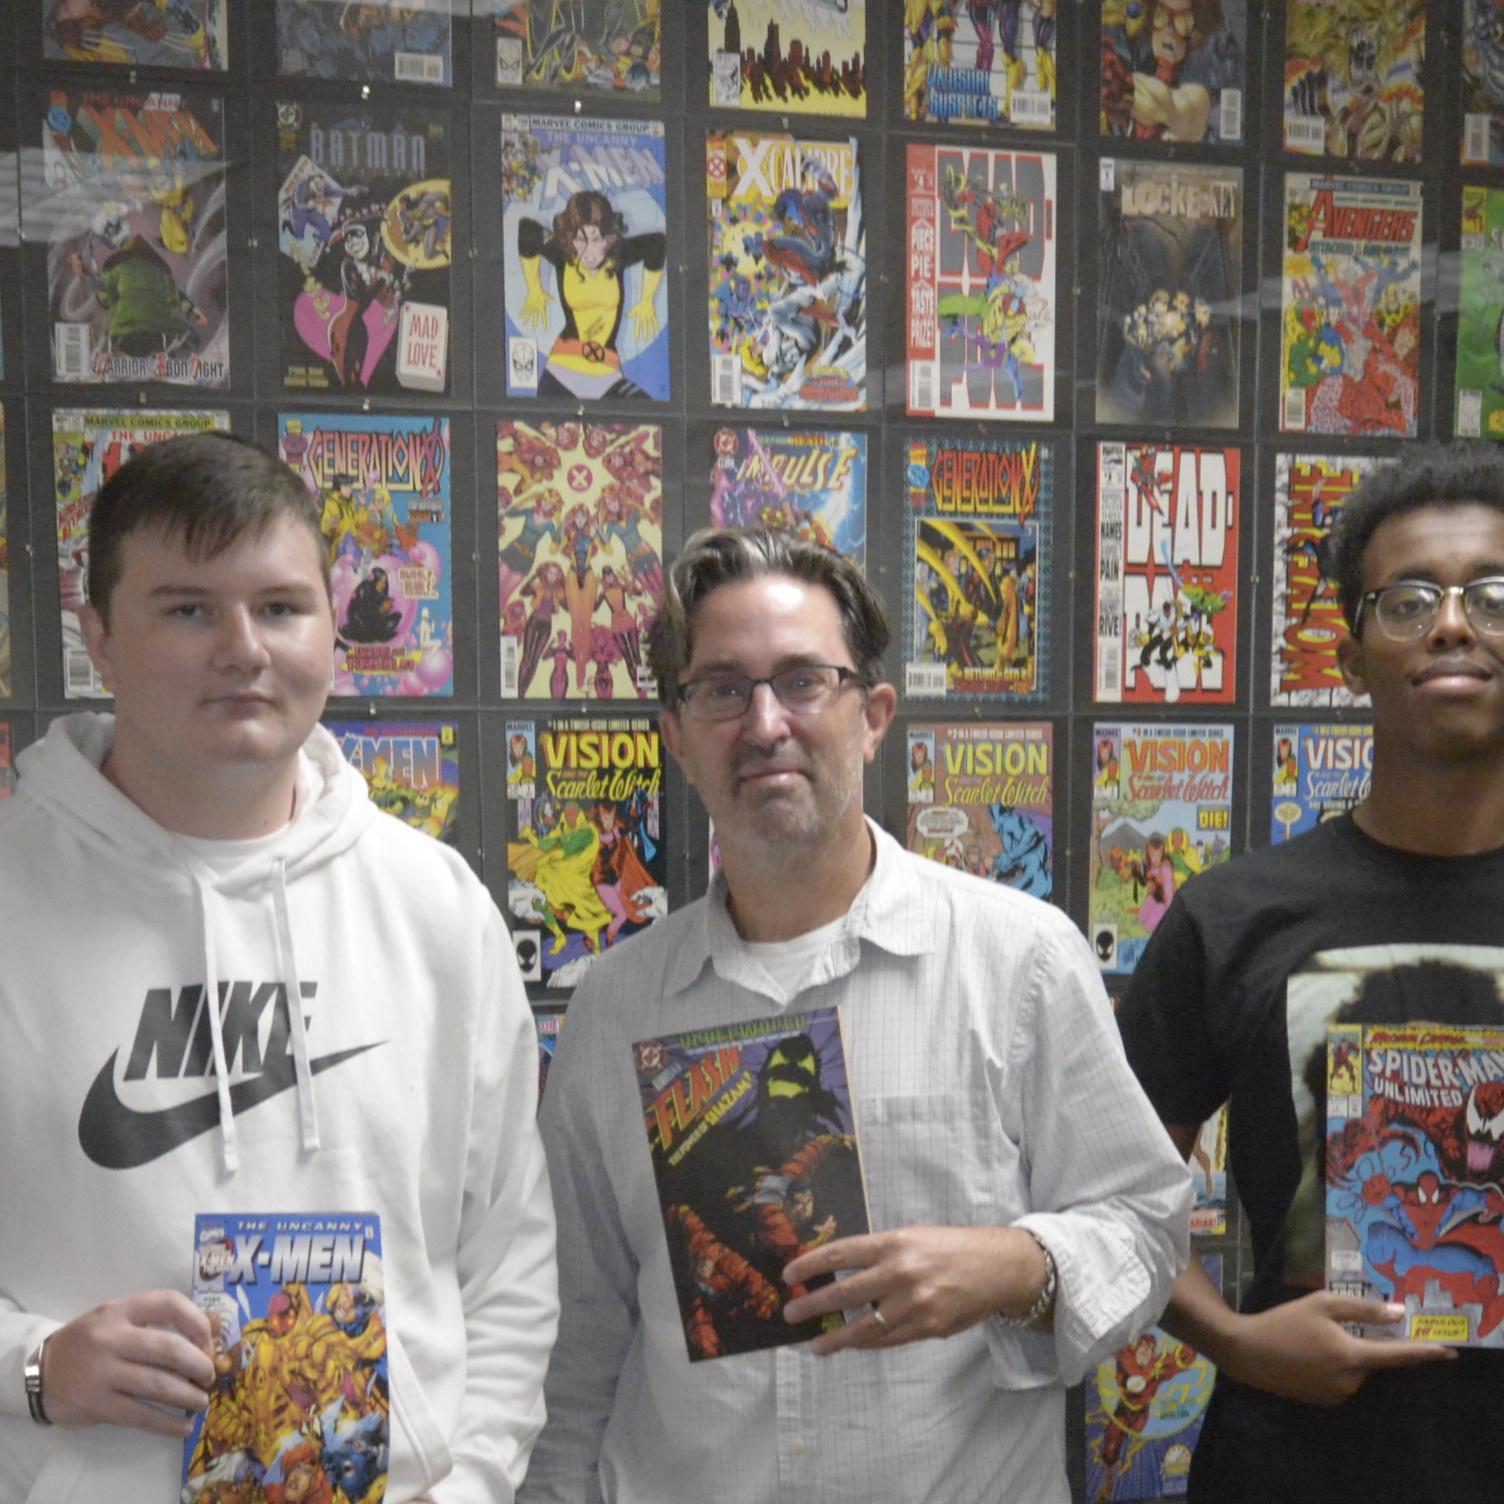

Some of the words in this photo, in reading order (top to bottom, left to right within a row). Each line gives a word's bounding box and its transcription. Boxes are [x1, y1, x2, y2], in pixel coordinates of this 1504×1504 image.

[532, 118, 571, 130] MARVEL
[574, 121, 612, 132] COMICS
[616, 122, 650, 134] GROUP
[548, 131, 574, 144] THE
[577, 132, 637, 147] UNCANNY
[310, 127, 426, 171] BATMAN
[539, 144, 663, 205] X-MEN
[1296, 172, 1418, 253] AVENGERS
[911, 224, 933, 251] PIECE
[409, 310, 439, 338] MAD
[407, 340, 439, 372] LOVE
[84, 417, 129, 427] MARVEL
[130, 417, 173, 427] COMICS
[175, 418, 212, 429] GROUP
[112, 430, 134, 441] THE
[540, 732, 661, 771] VISION
[944, 742, 1049, 776] VISION
[1126, 739, 1230, 773] VISION
[547, 769, 607, 799] Scarlet
[608, 768, 661, 803] Witch
[944, 777, 999, 806] Scarlet
[1000, 777, 1048, 804] Witch
[1127, 773, 1183, 802] Scarlet
[1183, 774, 1230, 802] Witch
[1304, 771, 1358, 801] Scarlet
[1199, 810, 1229, 830] DIE!
[123, 981, 318, 1082] NIKE
[649, 1046, 742, 1151] FLASH
[1373, 1076, 1464, 1108] UNLIMITED
[237, 1221, 267, 1232] THE
[277, 1221, 363, 1232] UNCANNY
[228, 1232, 367, 1287] X-MEN
